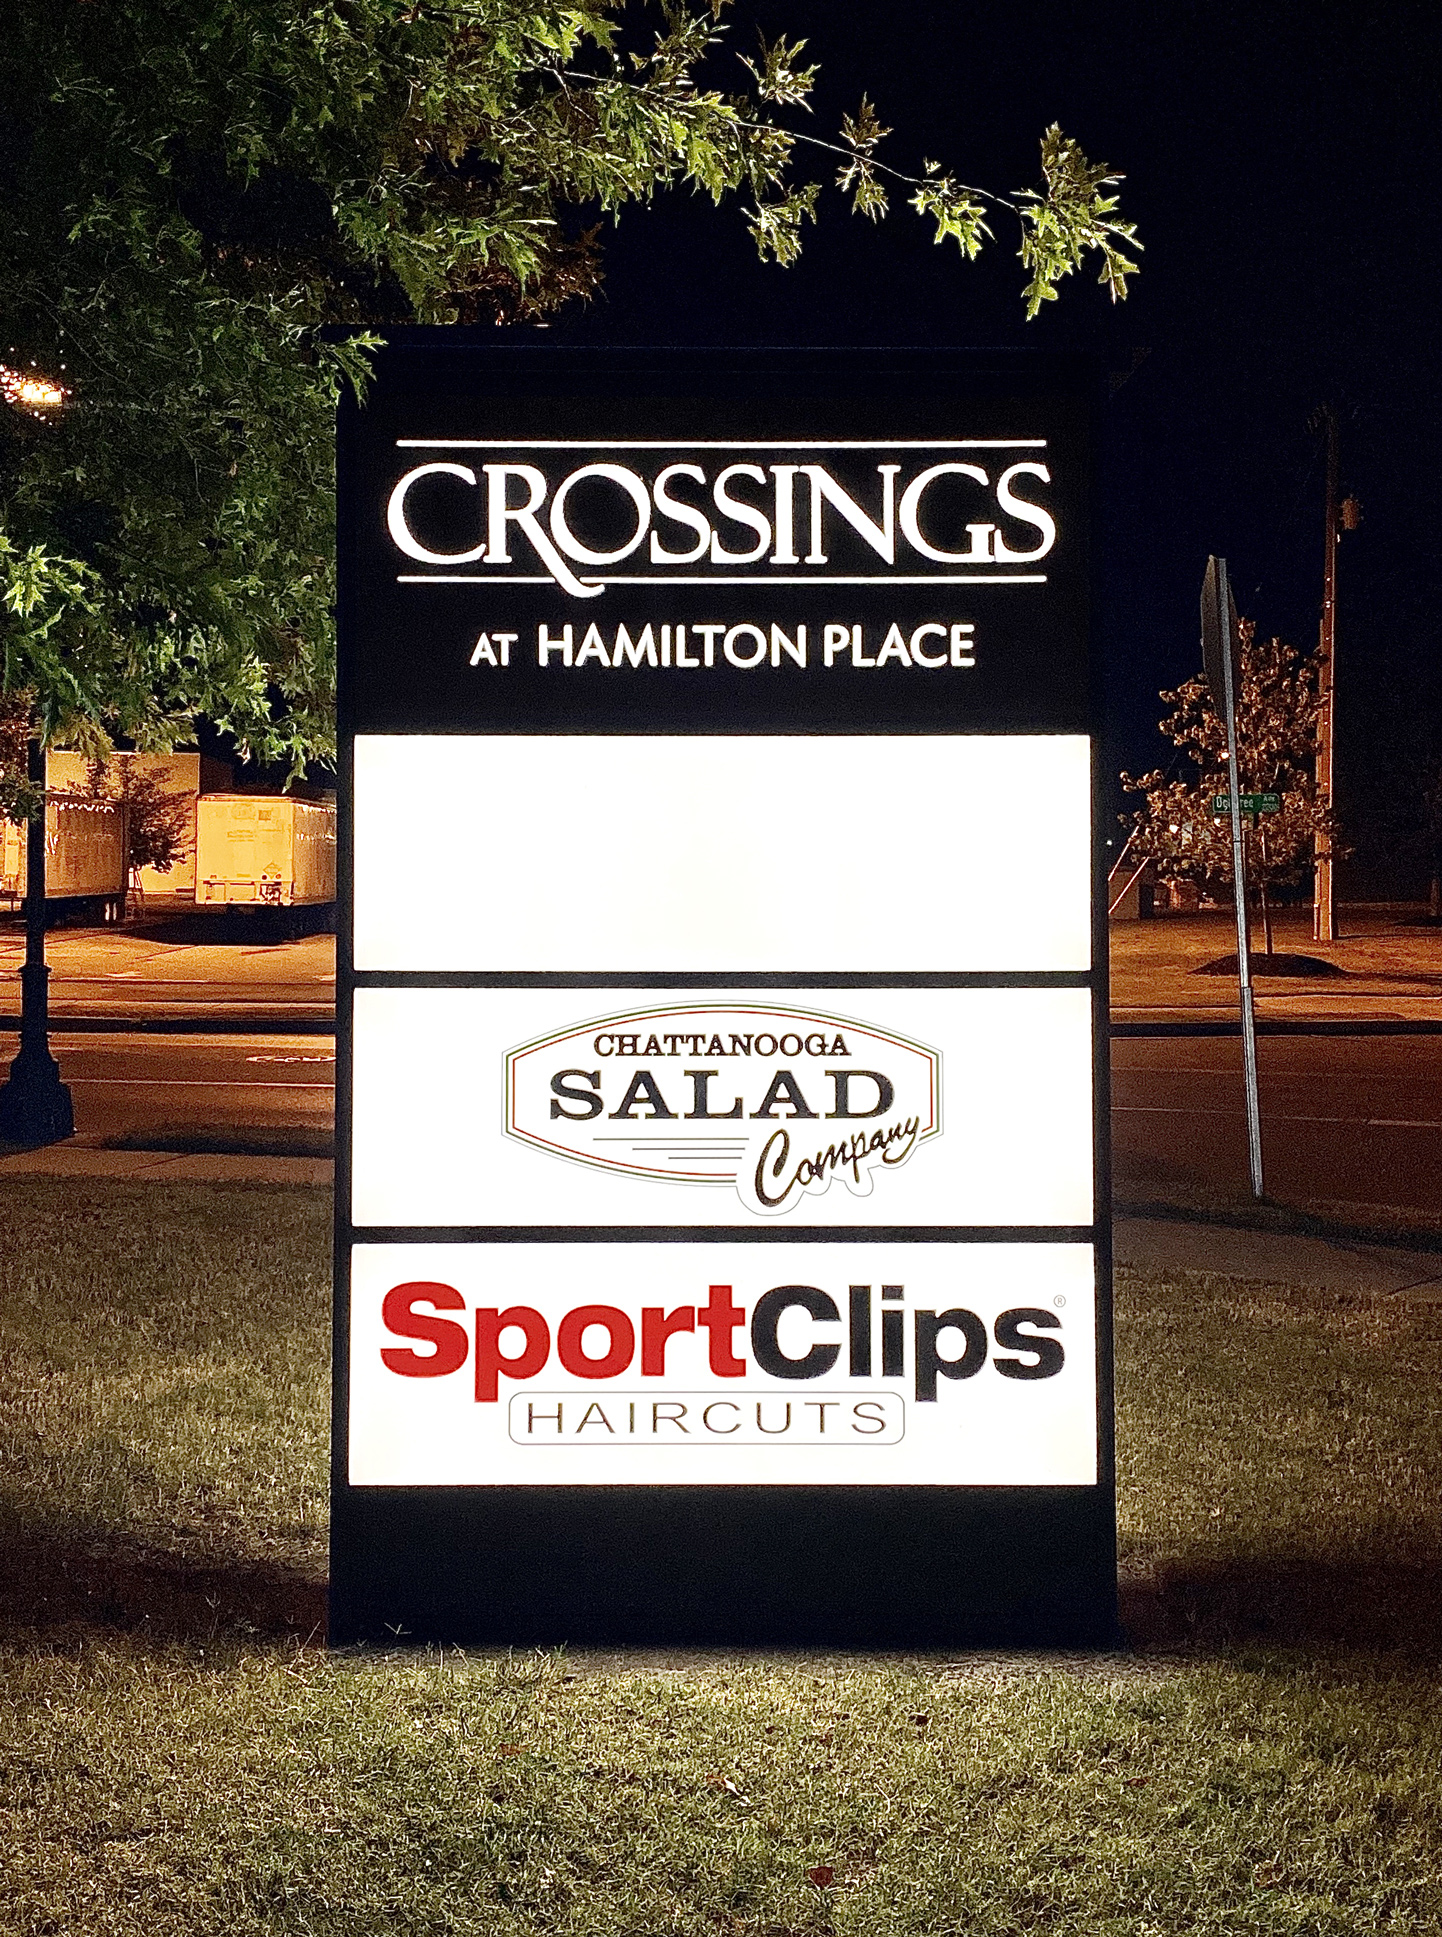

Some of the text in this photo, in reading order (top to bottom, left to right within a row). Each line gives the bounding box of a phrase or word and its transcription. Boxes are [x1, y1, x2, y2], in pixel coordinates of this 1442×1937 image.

[387, 462, 1056, 599] CROSSINGS
[469, 622, 976, 669] AT HAMILTON PLACE
[593, 1033, 852, 1057] CHATTANOOGA
[550, 1069, 894, 1121] SALAD
[754, 1115, 920, 1208] Company
[380, 1281, 1066, 1403] SportClips
[527, 1401, 886, 1434] HAIRCUTS
